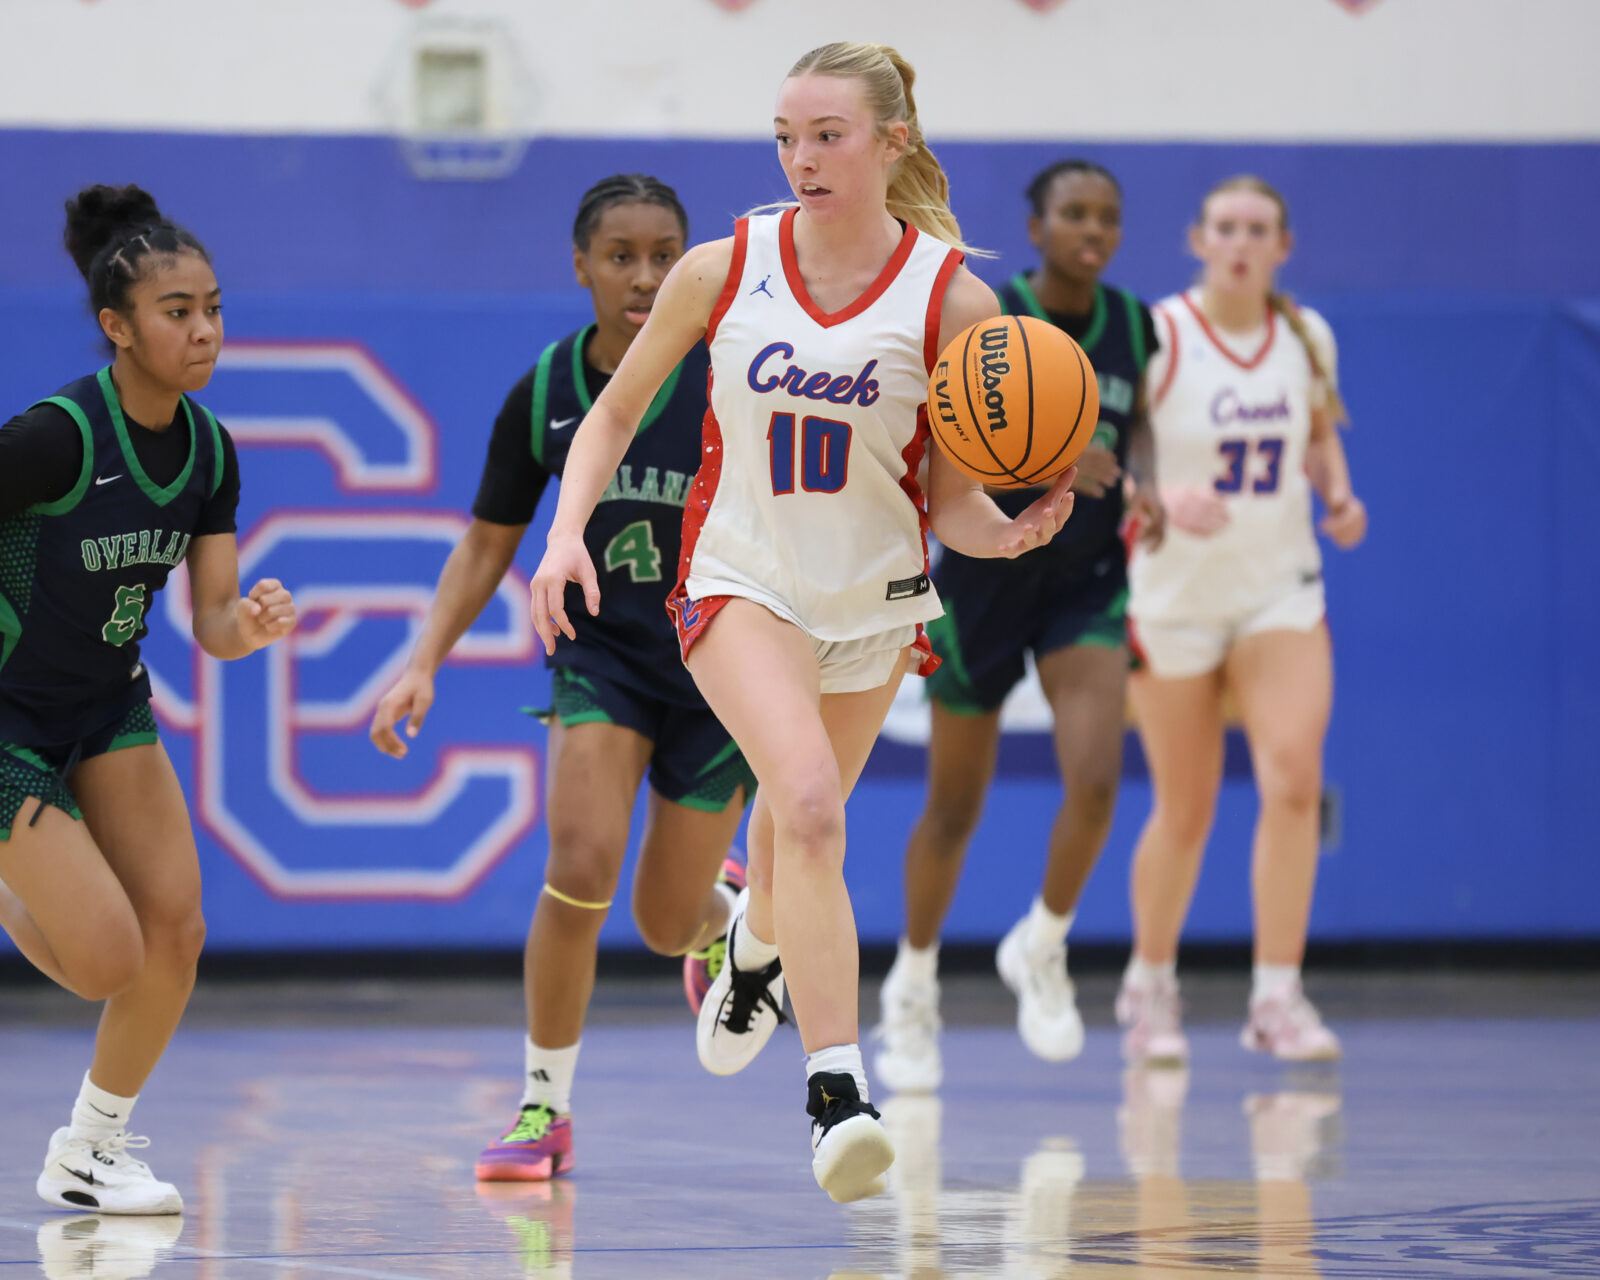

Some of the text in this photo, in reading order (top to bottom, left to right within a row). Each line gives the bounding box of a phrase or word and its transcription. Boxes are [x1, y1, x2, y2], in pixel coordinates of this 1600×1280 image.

[747, 341, 880, 407] Creek
[980, 325, 1011, 433] Wilson
[766, 411, 852, 497] 10
[953, 422, 972, 443] NXT
[1212, 438, 1285, 494] 33
[603, 519, 662, 583] 4
[101, 583, 146, 647] 5
